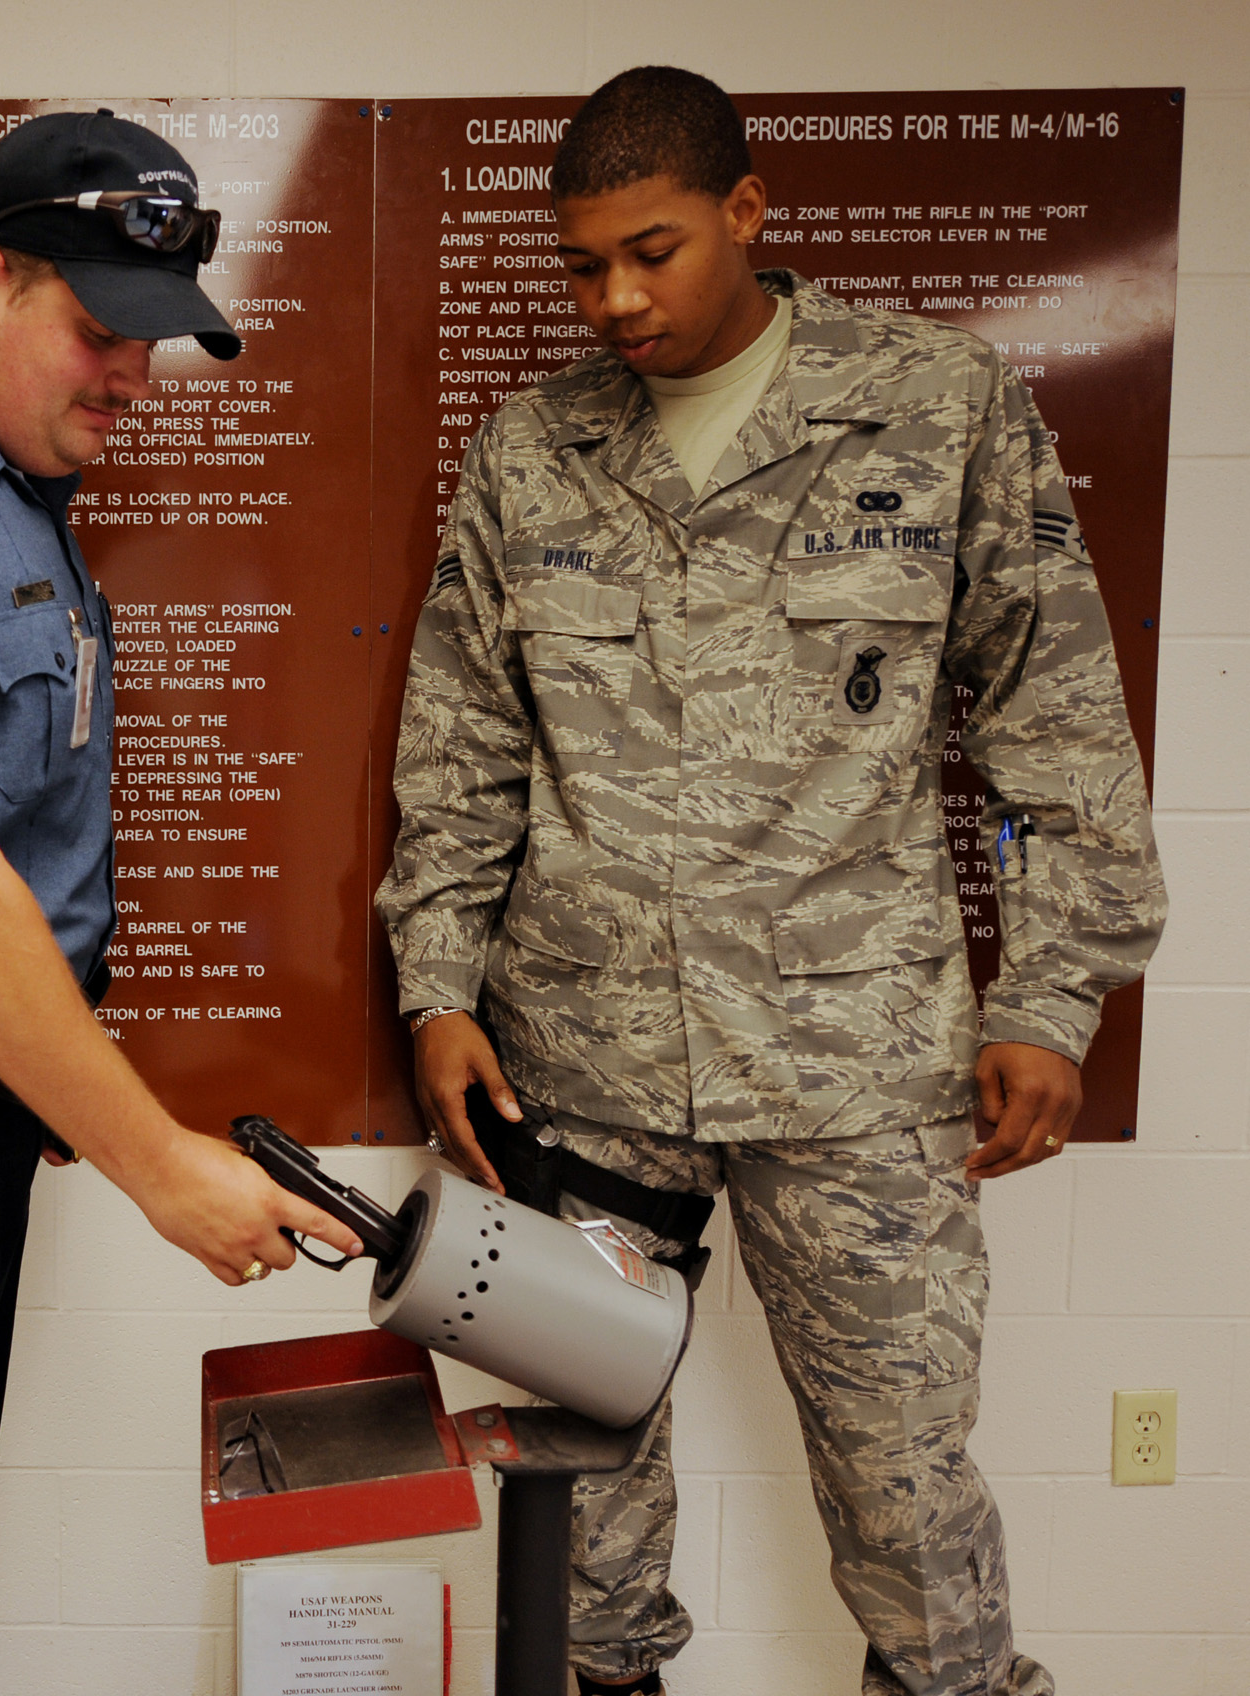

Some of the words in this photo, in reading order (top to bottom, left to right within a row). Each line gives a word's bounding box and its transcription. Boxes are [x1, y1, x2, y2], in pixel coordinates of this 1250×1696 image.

[157, 113, 198, 139] THE
[208, 113, 280, 140] M-203
[745, 115, 893, 142] PROCEDURES
[903, 114, 948, 141] FOR
[958, 114, 1001, 140] THE
[1010, 112, 1120, 139] M-4/M-16
[440, 167, 456, 192] 1.
[214, 180, 270, 195] "PORT"
[796, 206, 840, 221] ZONE
[846, 206, 886, 220] WITH
[892, 206, 923, 220] THE
[929, 206, 972, 220] RIFLE
[978, 206, 995, 220] IN
[1000, 205, 1032, 219] THE
[1038, 204, 1089, 219] "PORT
[256, 221, 332, 234] POSITION.
[439, 233, 493, 247] ARMS"
[498, 232, 560, 247] POSITIO
[762, 229, 804, 244] REAR
[810, 229, 844, 243] AND
[850, 228, 932, 243] SELECTOR
[938, 228, 988, 242] LEVER
[994, 228, 1011, 242] IN
[1017, 227, 1048, 242] THE
[214, 239, 284, 254] LEARING
[233, 317, 275, 331] AREA
[1015, 342, 1047, 356] THE
[1054, 342, 1109, 356] "SAFE"
[158, 379, 180, 393] TO
[186, 379, 230, 393] MOVE
[236, 379, 258, 394] TO
[264, 380, 294, 394] THE
[138, 433, 207, 447] OFFICIAL
[214, 432, 315, 447] IMMEDIATELY.
[804, 530, 844, 554] U.S.
[852, 527, 884, 550] AIR
[891, 525, 942, 550] FORCE
[542, 549, 595, 571] DRAKE
[109, 603, 158, 617] "PORT
[163, 604, 215, 617] ARMS"
[221, 603, 296, 617] POSITION.
[112, 621, 161, 634] ENTER
[167, 620, 198, 634] THE
[204, 620, 280, 634] CLEARING
[119, 735, 226, 749] PROCEDURES.
[118, 753, 166, 767] LEVER
[172, 752, 187, 766] IS
[193, 753, 209, 766] IN
[214, 752, 244, 766] THE
[251, 752, 304, 766] "SAFE"
[113, 829, 155, 842] AREA
[160, 828, 181, 842] TO
[187, 828, 248, 842] ENSURE
[971, 925, 995, 939] NO
[301, 1597, 328, 1606] USAF
[330, 1595, 383, 1605] WEAPONS
[289, 1608, 345, 1619] HANDLING
[348, 1607, 395, 1617] MANUAL
[327, 1620, 357, 1629] 31-229
[292, 1639, 353, 1648] SEMIAUTOMATIC
[355, 1638, 380, 1646] PISTOL
[327, 1654, 353, 1662] RIFLES
[313, 1670, 348, 1678] SHOTGUN
[300, 1687, 335, 1695] GRENADE
[336, 1686, 376, 1694] LAUNCHER
